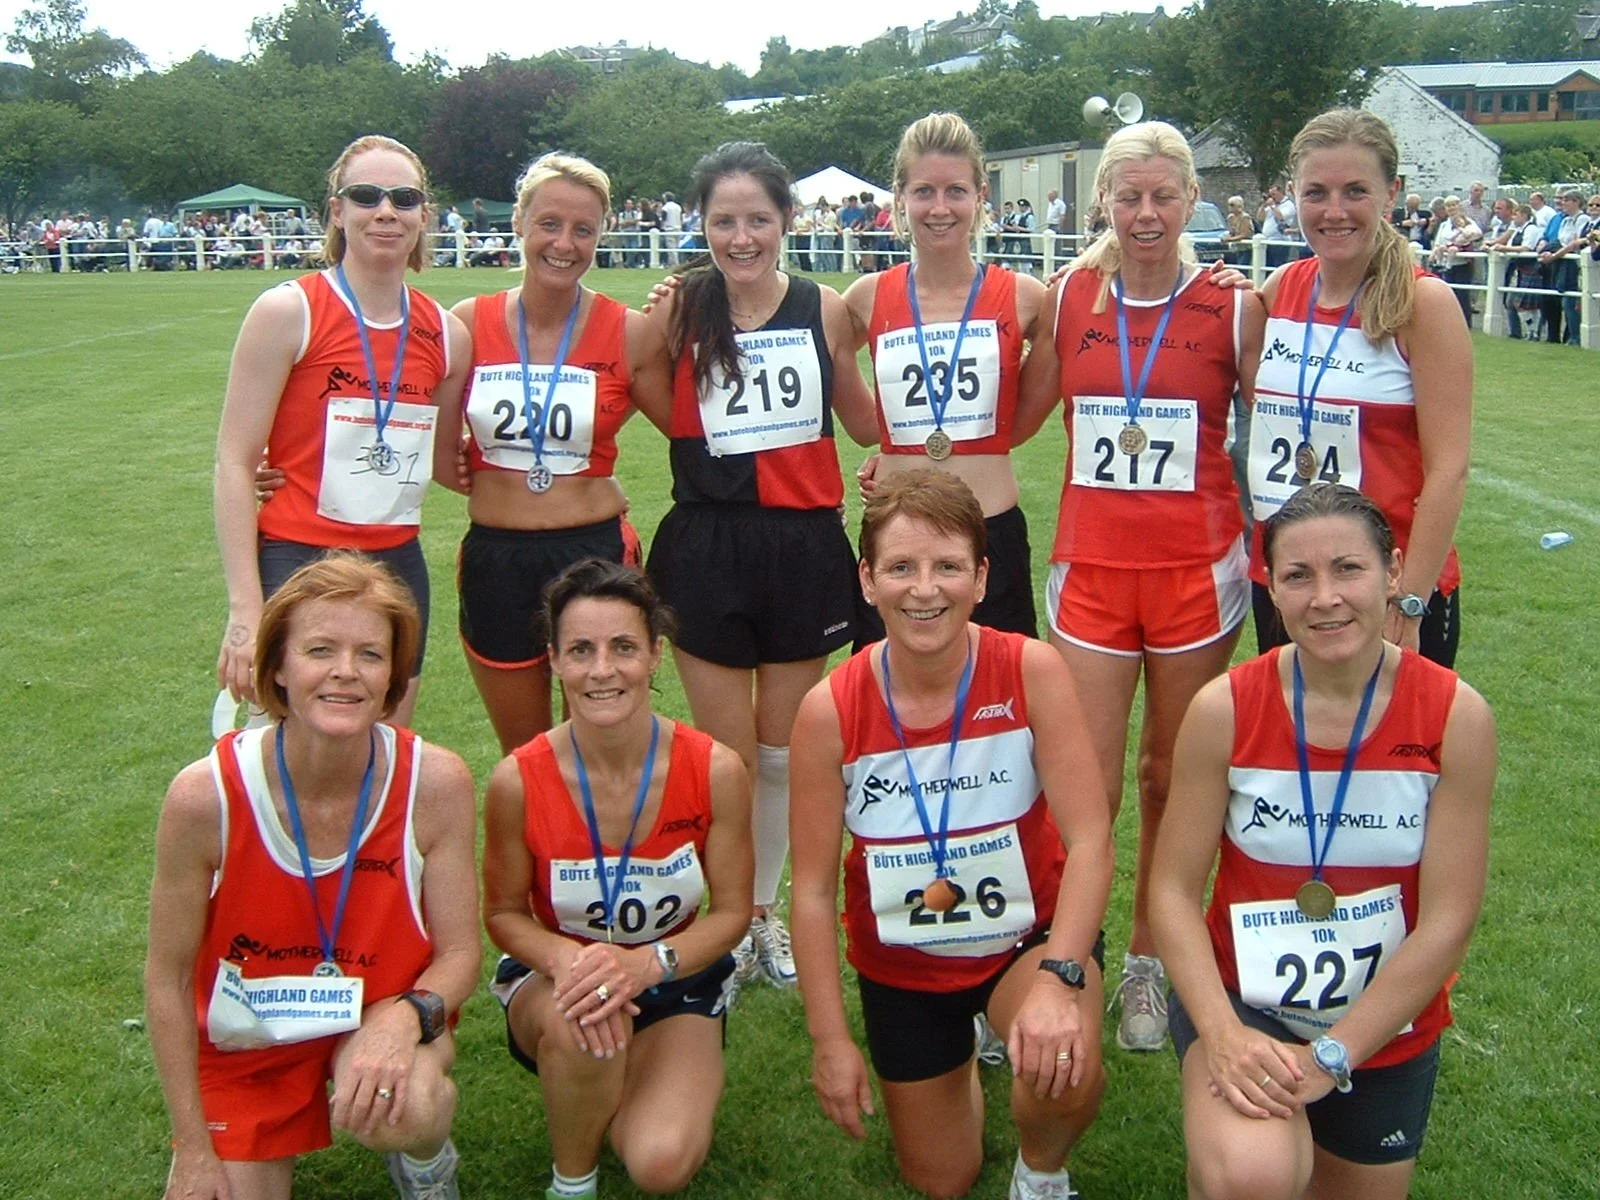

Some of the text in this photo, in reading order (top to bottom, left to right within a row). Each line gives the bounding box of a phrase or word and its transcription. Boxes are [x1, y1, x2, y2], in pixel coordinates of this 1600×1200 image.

[736, 336, 808, 350] GHLAND GAMES
[883, 336, 906, 349] BUTE
[908, 330, 956, 345] HIHLAND
[959, 327, 992, 338] AMES
[1107, 334, 1177, 349] MOHERELL
[748, 354, 765, 366] 10k
[929, 345, 945, 357] 10k
[480, 370, 590, 384] BUTE HIGLAND GAMES
[902, 357, 980, 407] 235
[723, 366, 801, 416] 219
[493, 399, 572, 442] 220
[1079, 403, 1192, 419] BUTE HIGHND GAMES
[1256, 401, 1353, 426] BUTE HIGHD GAMES
[1094, 437, 1174, 485] 217
[1289, 813, 1388, 830] MOHRWELL
[874, 835, 1013, 869] BUTE HIGHAND GAMES
[559, 854, 693, 882] BUTE GLAND GAMES
[904, 876, 1007, 927] 226
[1242, 912, 1277, 929] BUTE
[1352, 897, 1395, 920] GAMES
[585, 894, 682, 934] 202
[1312, 927, 1337, 944] 10k
[267, 946, 353, 964] MOTHERELL
[1275, 942, 1383, 1011] 227
[246, 988, 307, 1005] HIGHLAND
[310, 988, 353, 1005] GAMES
